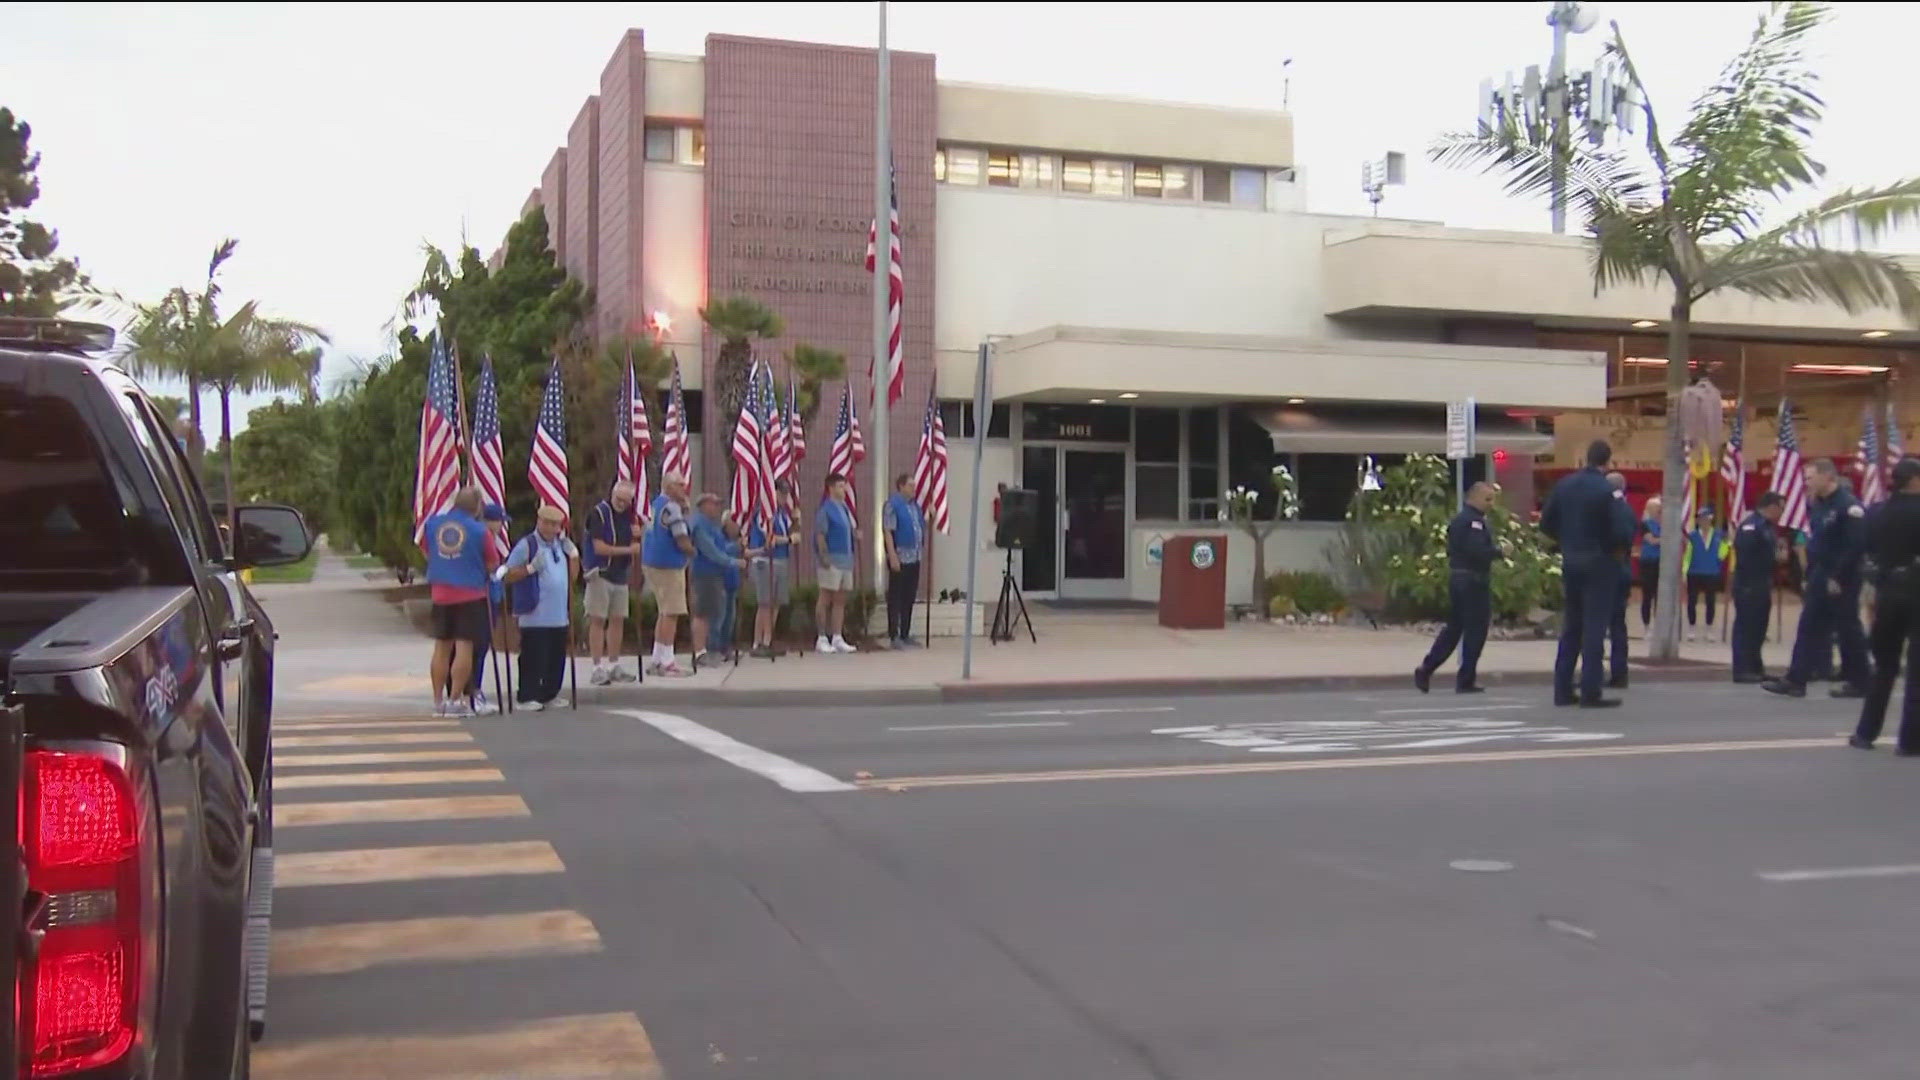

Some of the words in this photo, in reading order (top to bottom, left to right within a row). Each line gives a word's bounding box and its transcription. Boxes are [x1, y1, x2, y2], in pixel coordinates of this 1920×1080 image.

[731, 213, 772, 227] CITY
[731, 242, 763, 259] FIRE
[774, 246, 866, 265] DEPARTME
[732, 275, 868, 295] HEADQUARTERS
[1058, 423, 1091, 437] 1001
